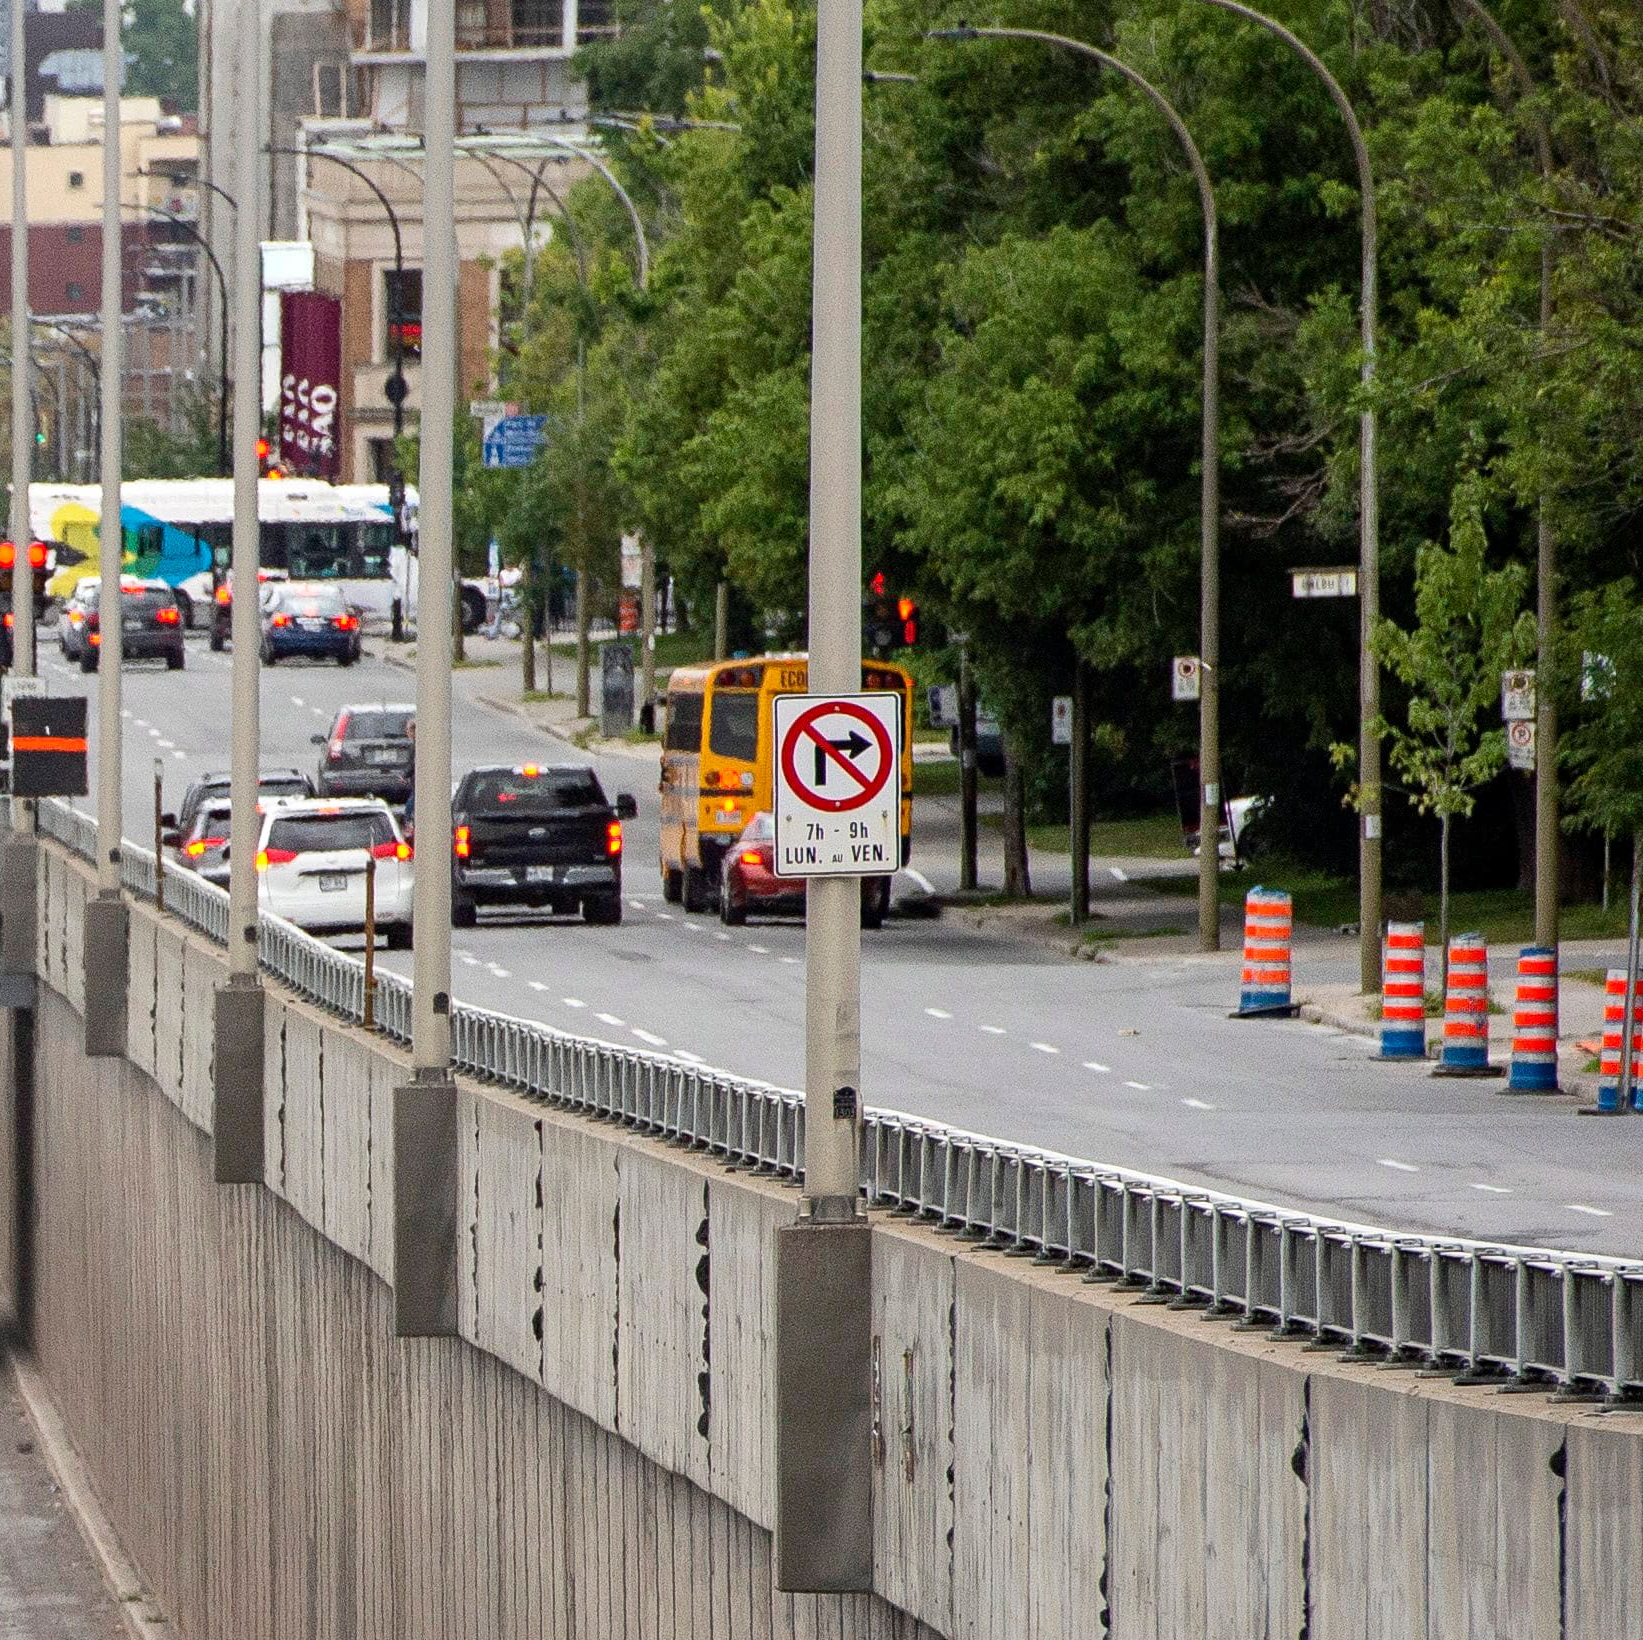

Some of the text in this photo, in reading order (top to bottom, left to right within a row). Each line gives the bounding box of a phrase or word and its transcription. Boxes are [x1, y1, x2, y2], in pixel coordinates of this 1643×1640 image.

[806, 823, 824, 841] 7h
[849, 821, 868, 839] 9h
[785, 844, 890, 864] LUN. AU VEN.
